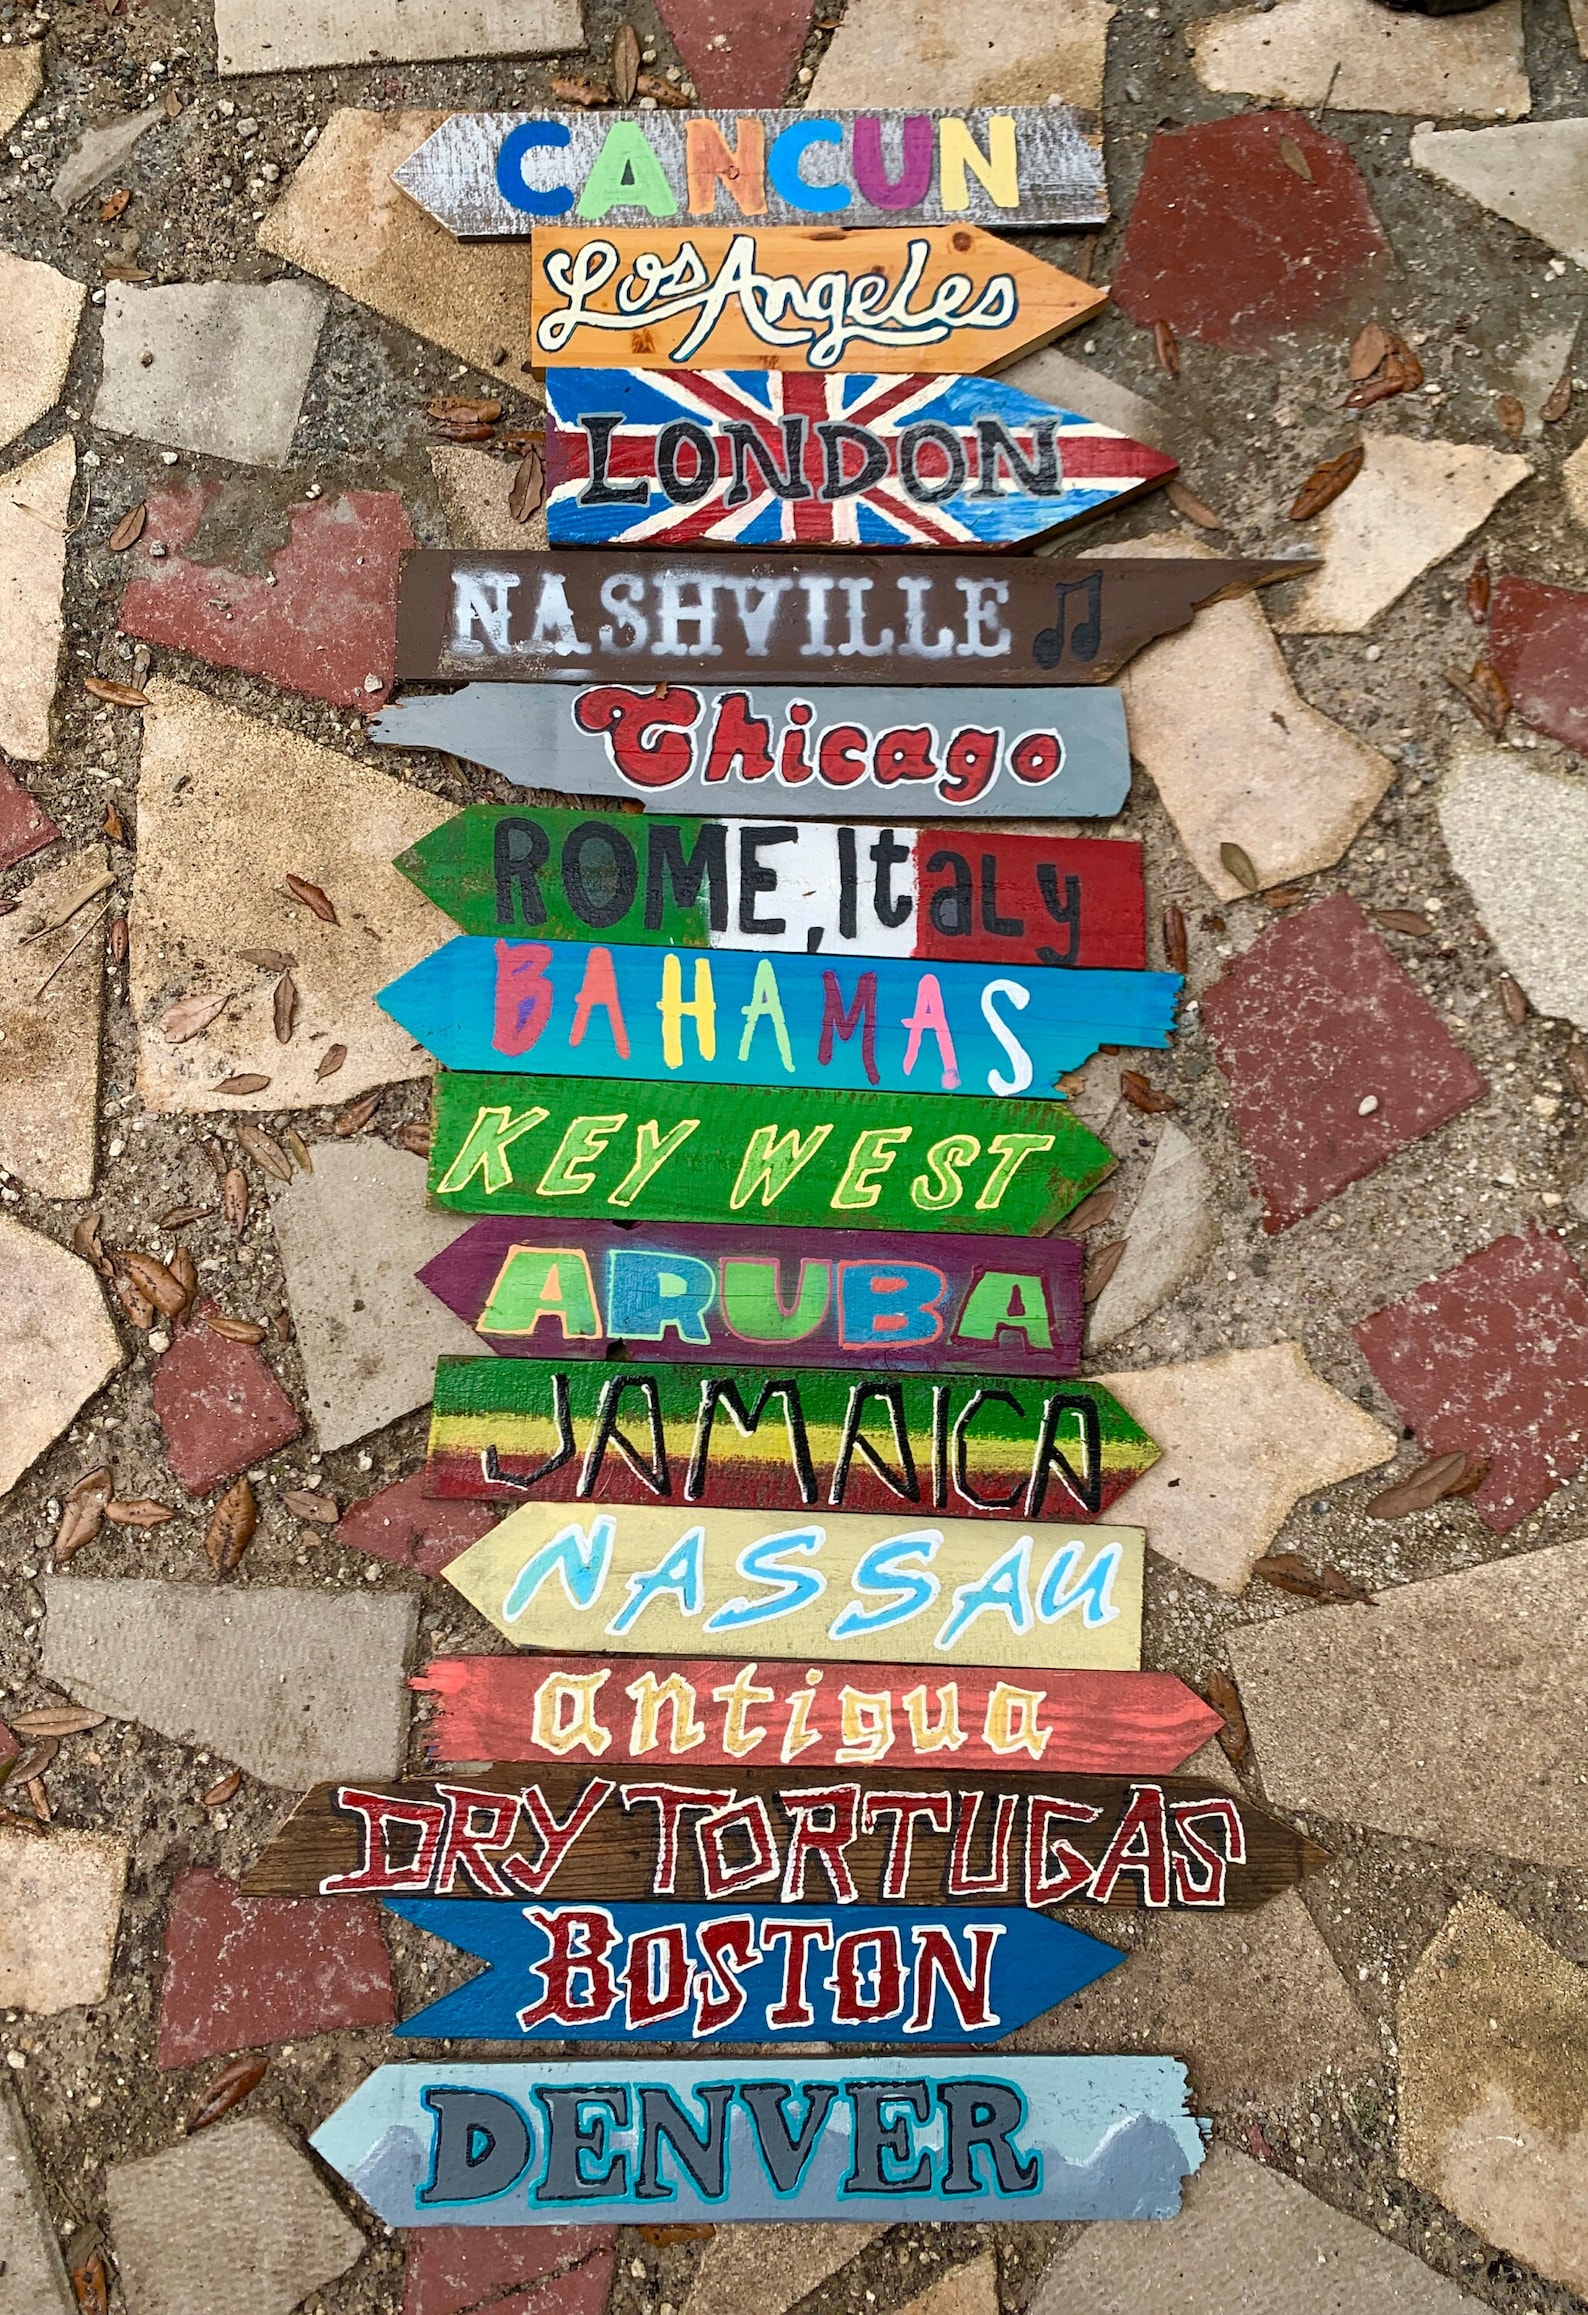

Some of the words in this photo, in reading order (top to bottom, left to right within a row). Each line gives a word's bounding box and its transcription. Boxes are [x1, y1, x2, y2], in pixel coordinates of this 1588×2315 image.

[496, 115, 1020, 216] CANCUN
[536, 239, 707, 353] Los
[671, 234, 1018, 371] Angeles
[576, 411, 1064, 509] LONDON
[450, 570, 1012, 659] NASHVILLE
[574, 685, 1066, 806] Chicago
[492, 938, 1032, 1097] BAHAMAS
[437, 1106, 699, 1206] KEY
[729, 1124, 1055, 1211] WEST
[475, 1244, 1055, 1350] ARUBA
[482, 1374, 1102, 1517] JAMAICA
[503, 1513, 1122, 1650] NASSAU
[531, 1662, 1055, 1763] antigua
[319, 1777, 611, 1905] DRY
[620, 1783, 1247, 1907] TORTUGAS
[519, 1905, 1006, 2036] BOSTON
[415, 2076, 1038, 2208] DENVER
